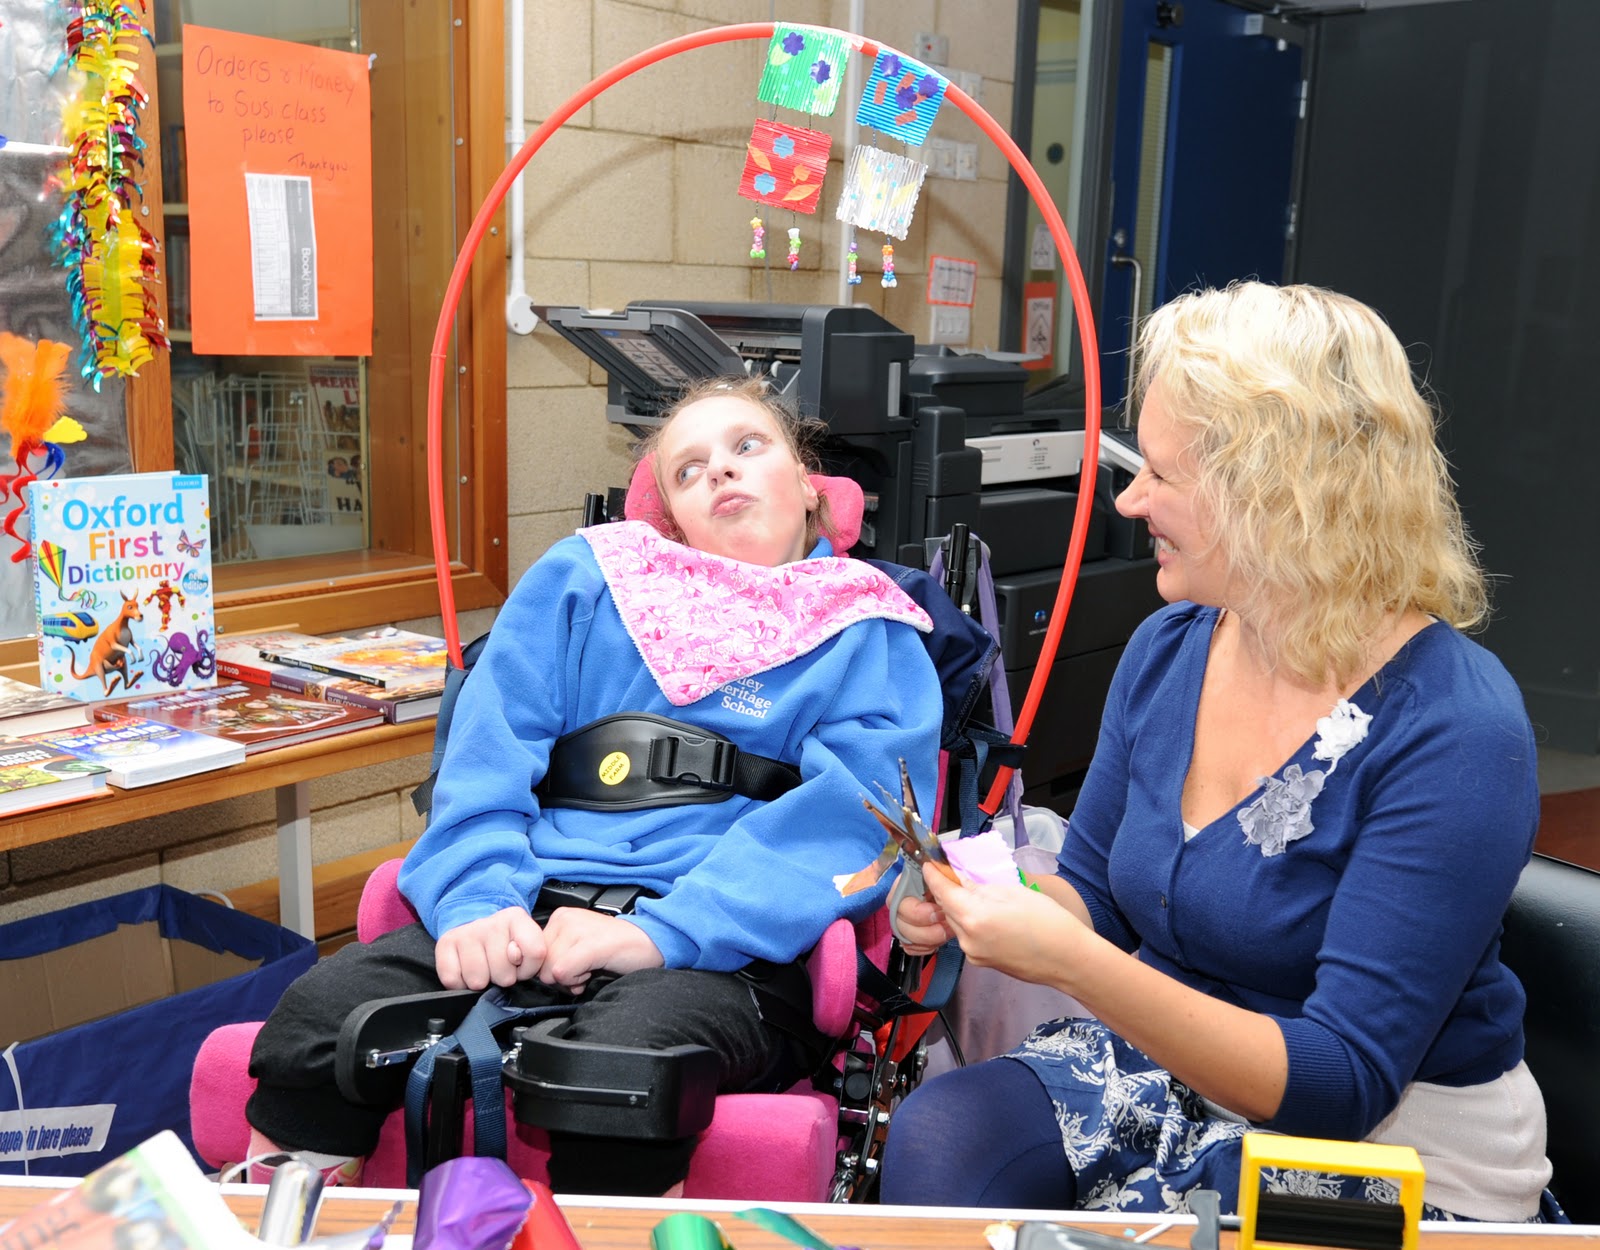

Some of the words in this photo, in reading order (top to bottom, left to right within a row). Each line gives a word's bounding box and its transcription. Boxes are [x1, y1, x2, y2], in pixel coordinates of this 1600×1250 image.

[197, 45, 271, 82] Orders
[299, 63, 355, 105] Money
[207, 91, 225, 113] to
[281, 99, 327, 123] class
[242, 127, 295, 152] please
[62, 493, 184, 530] Oxford
[89, 530, 163, 561] First
[68, 561, 184, 585] Dictionary
[721, 695, 768, 719] School
[56, 723, 167, 748] Britain
[36, 1125, 61, 1151] here
[59, 1123, 93, 1151] please
